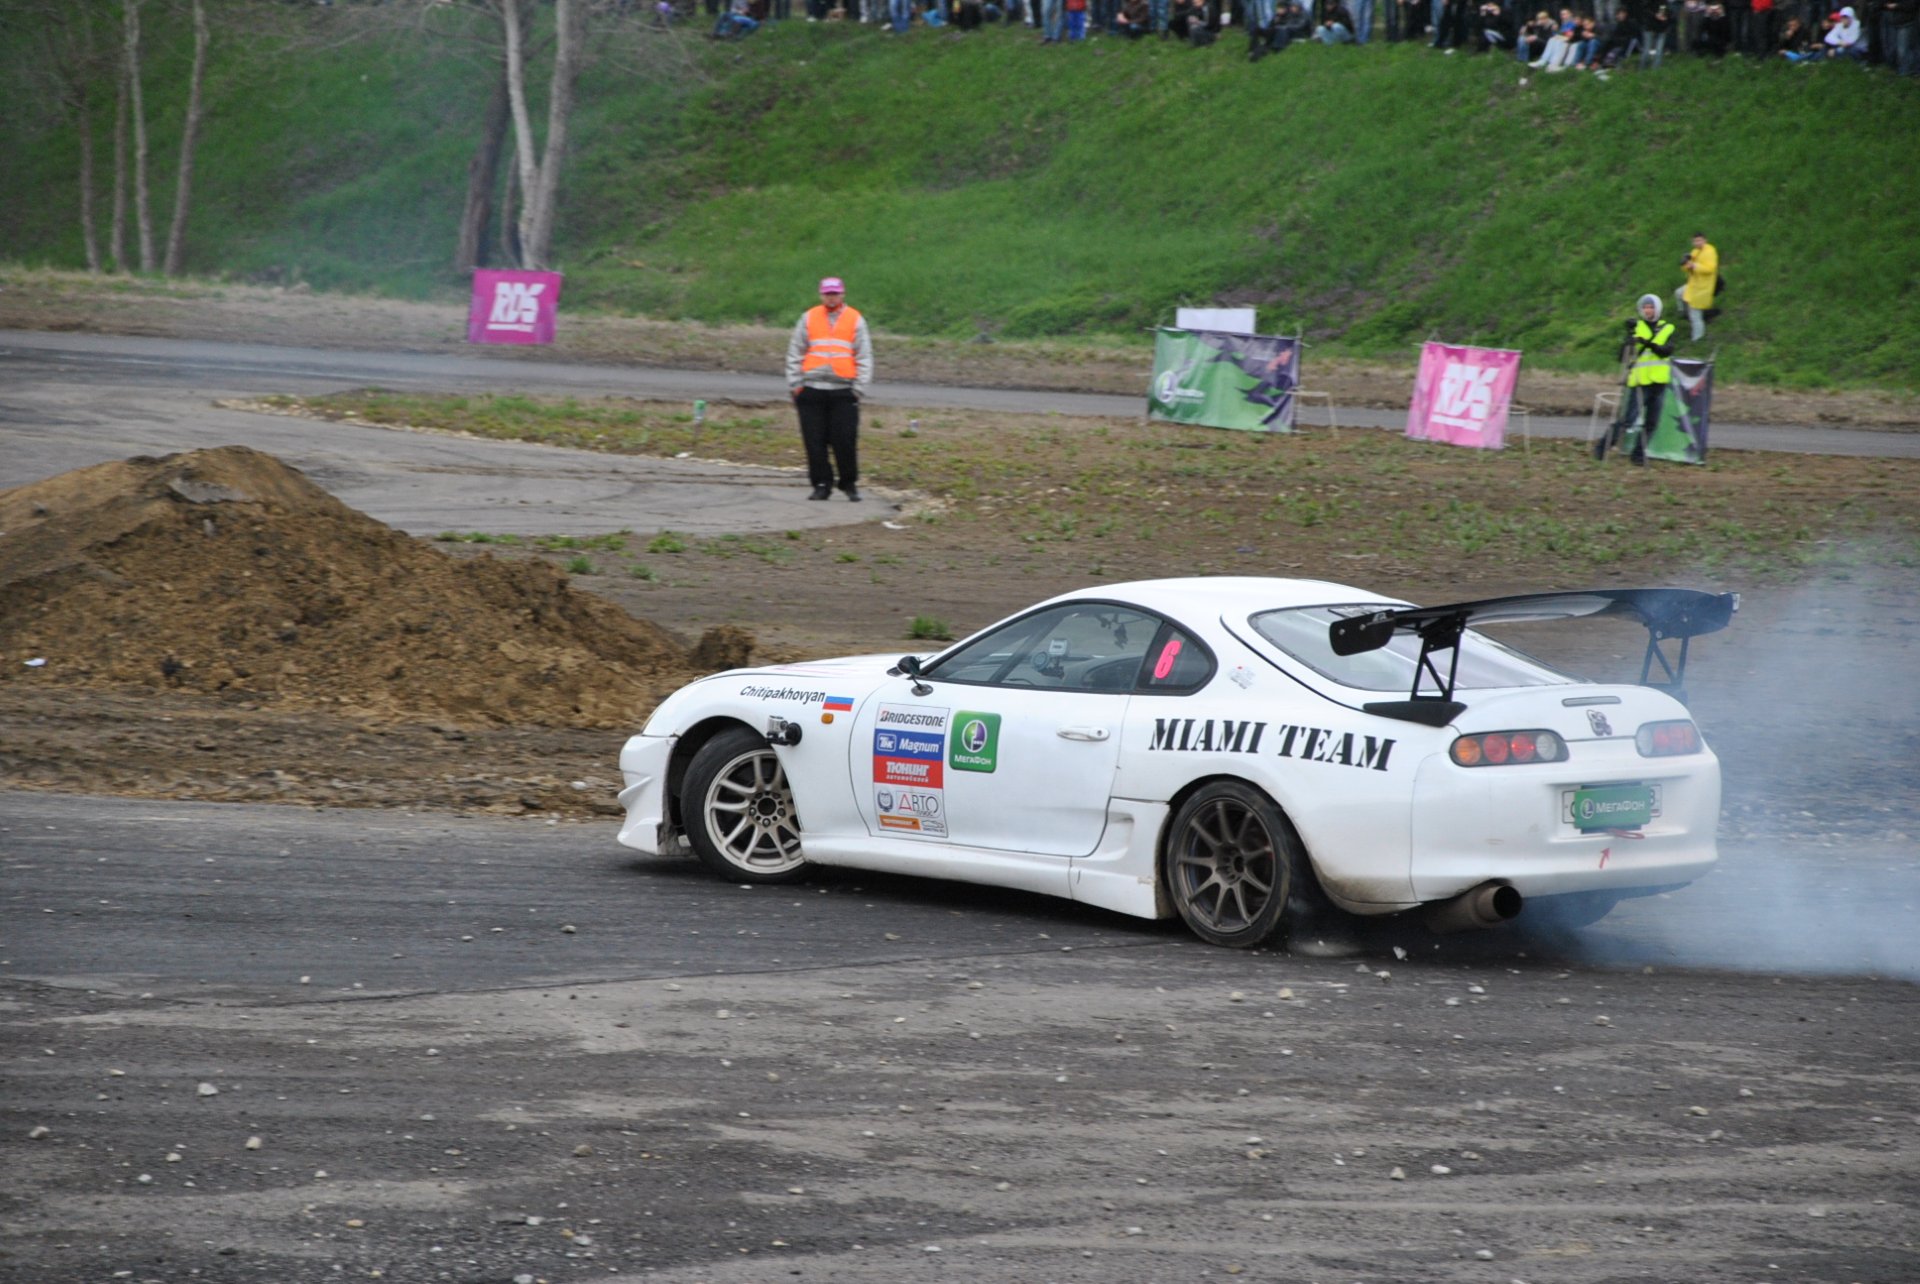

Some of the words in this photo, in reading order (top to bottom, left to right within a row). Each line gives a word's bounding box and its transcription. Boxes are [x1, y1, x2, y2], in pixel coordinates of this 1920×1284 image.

[1154, 640, 1181, 679] 6
[740, 686, 826, 704] Chitipakhovyan
[880, 710, 945, 728] BRIDGESTONE
[899, 738, 939, 754] Magnum
[1148, 718, 1267, 754] MIAMI
[1278, 724, 1397, 772] TEAM
